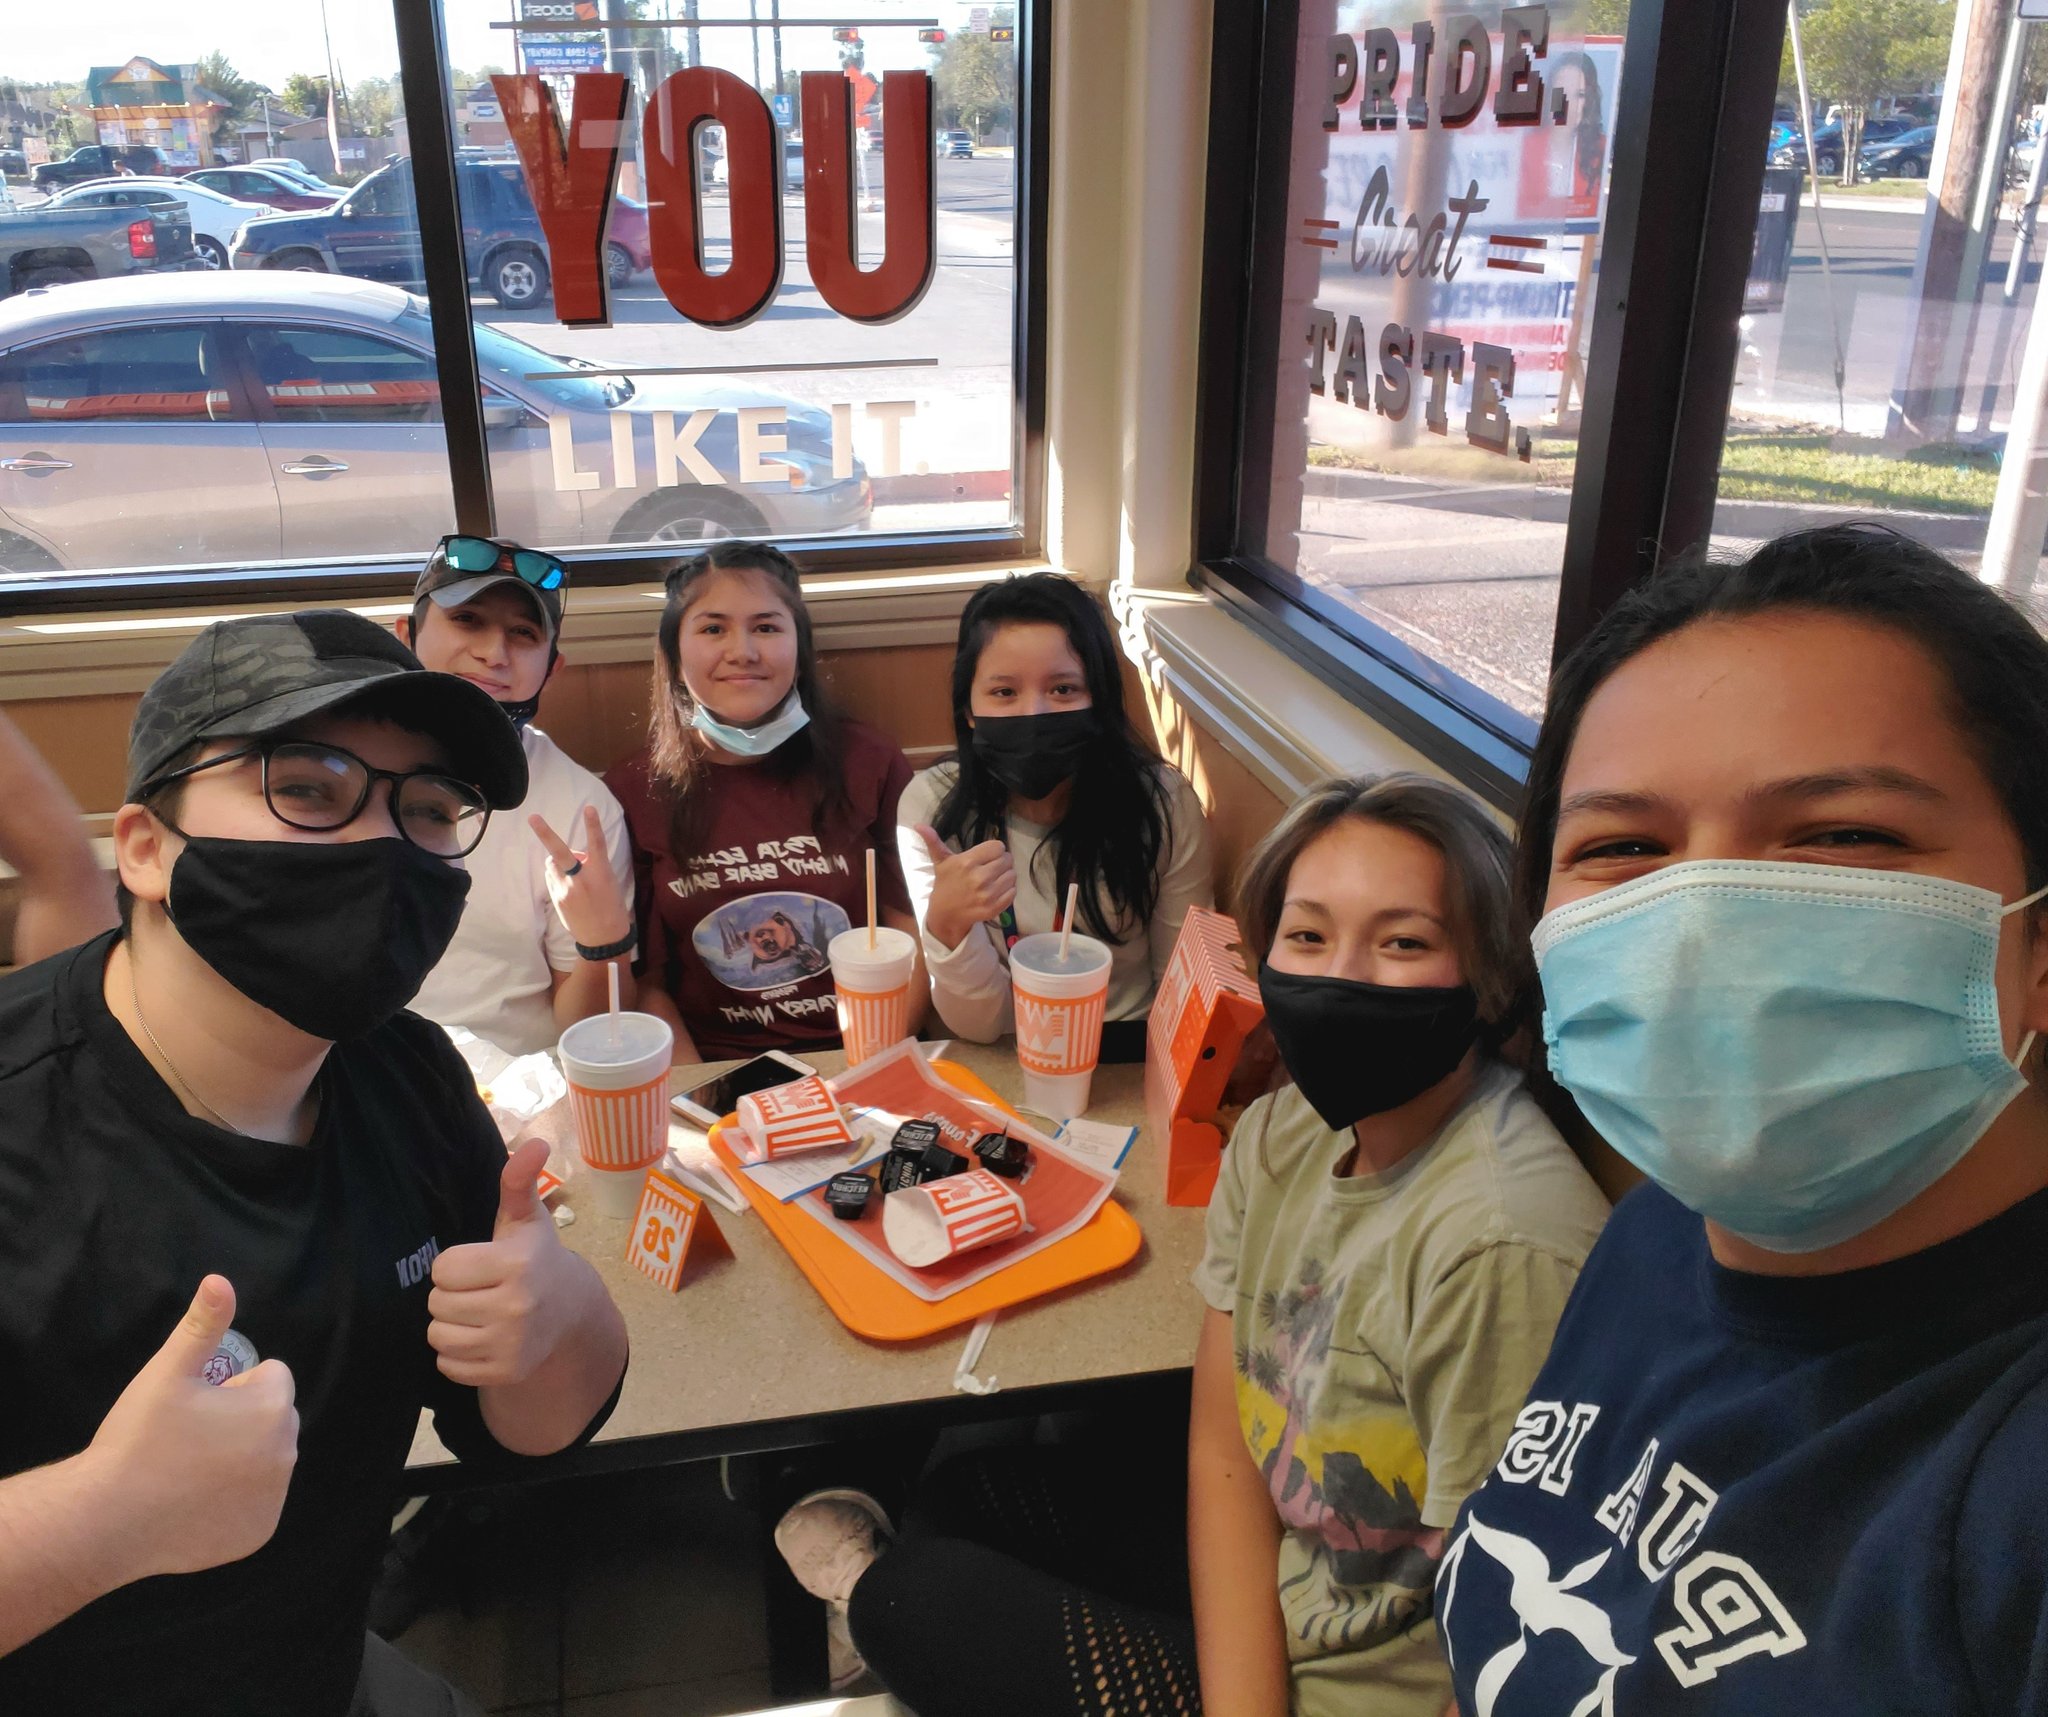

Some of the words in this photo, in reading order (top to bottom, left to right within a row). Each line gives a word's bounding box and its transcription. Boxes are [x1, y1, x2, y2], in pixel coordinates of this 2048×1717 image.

[1323, 4, 1568, 131] PRIDE.
[490, 66, 937, 332] YOU
[1351, 165, 1490, 282] Great
[1305, 306, 1532, 463] TASTE.
[548, 406, 790, 492] LIKE
